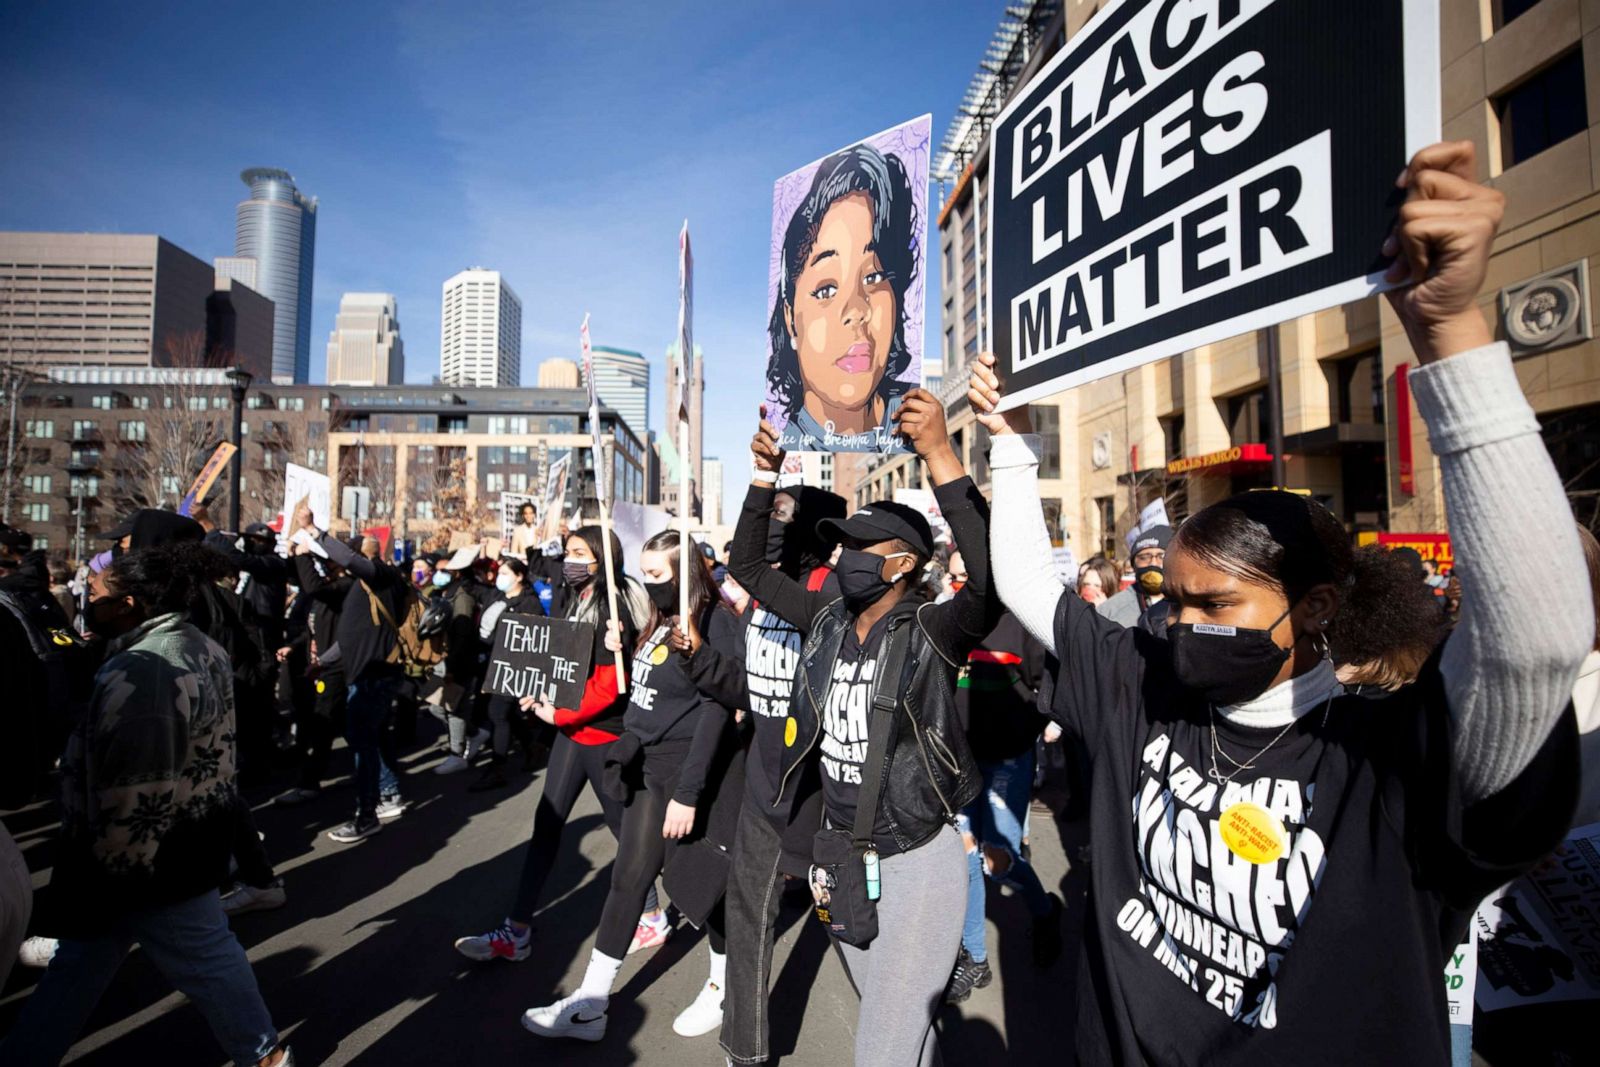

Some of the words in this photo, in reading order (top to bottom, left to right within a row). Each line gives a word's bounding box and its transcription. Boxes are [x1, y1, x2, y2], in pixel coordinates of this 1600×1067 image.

[1032, 50, 1268, 264] LIVES
[1018, 165, 1309, 361] MATTER
[799, 433, 816, 452] for
[824, 420, 870, 449] Breonna
[1168, 457, 1202, 474] WELLS
[1204, 447, 1242, 467] FARGO
[1386, 541, 1454, 562] ELL
[502, 619, 551, 654] TEACH
[1216, 626, 1233, 634] STEVE
[551, 655, 580, 683] THE
[1142, 733, 1171, 773] A
[1229, 821, 1269, 854] ANTI-WAR!
[1231, 811, 1279, 850] ANTI-RACIST
[1116, 898, 1161, 949] ON
